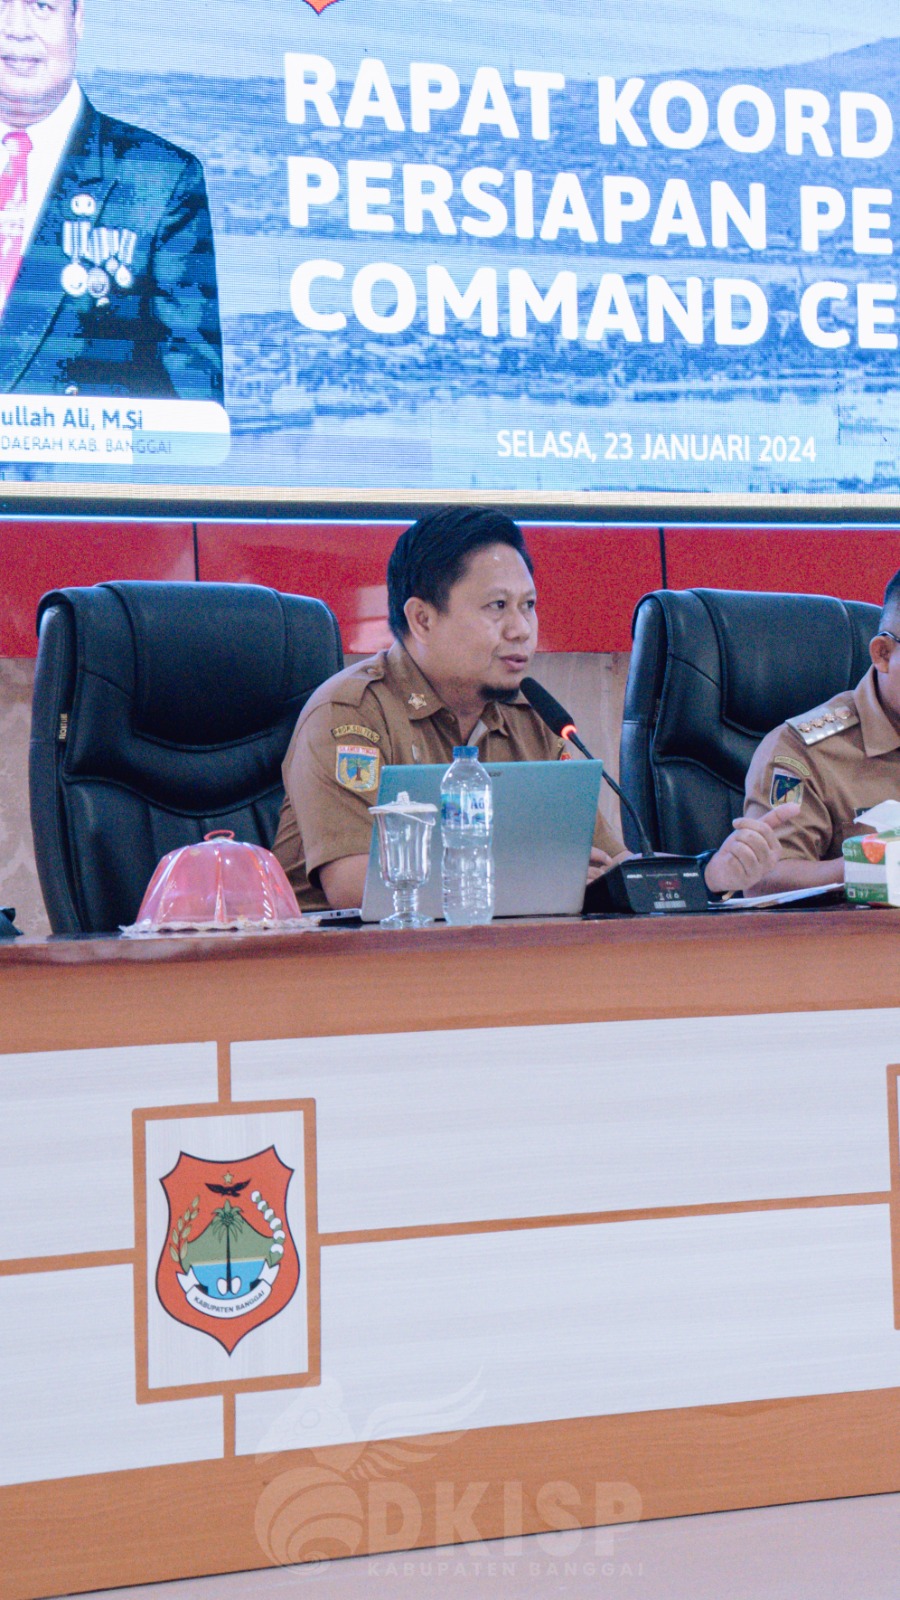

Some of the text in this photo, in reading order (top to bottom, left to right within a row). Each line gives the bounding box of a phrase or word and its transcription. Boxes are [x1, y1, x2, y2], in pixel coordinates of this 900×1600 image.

[284, 52, 893, 159] RAPAT KOORD
[287, 156, 893, 254] PERSIAPAN PE
[289, 259, 898, 349] COMMAND CE
[1, 405, 143, 431] ullah Ali, M.Si
[1, 435, 63, 451] DAERAH
[105, 438, 172, 455] BANGGAI
[497, 429, 817, 463] SELASA, 23 JANUARI 2024
[194, 1290, 265, 1313] KABUPATEN BANGGAI
